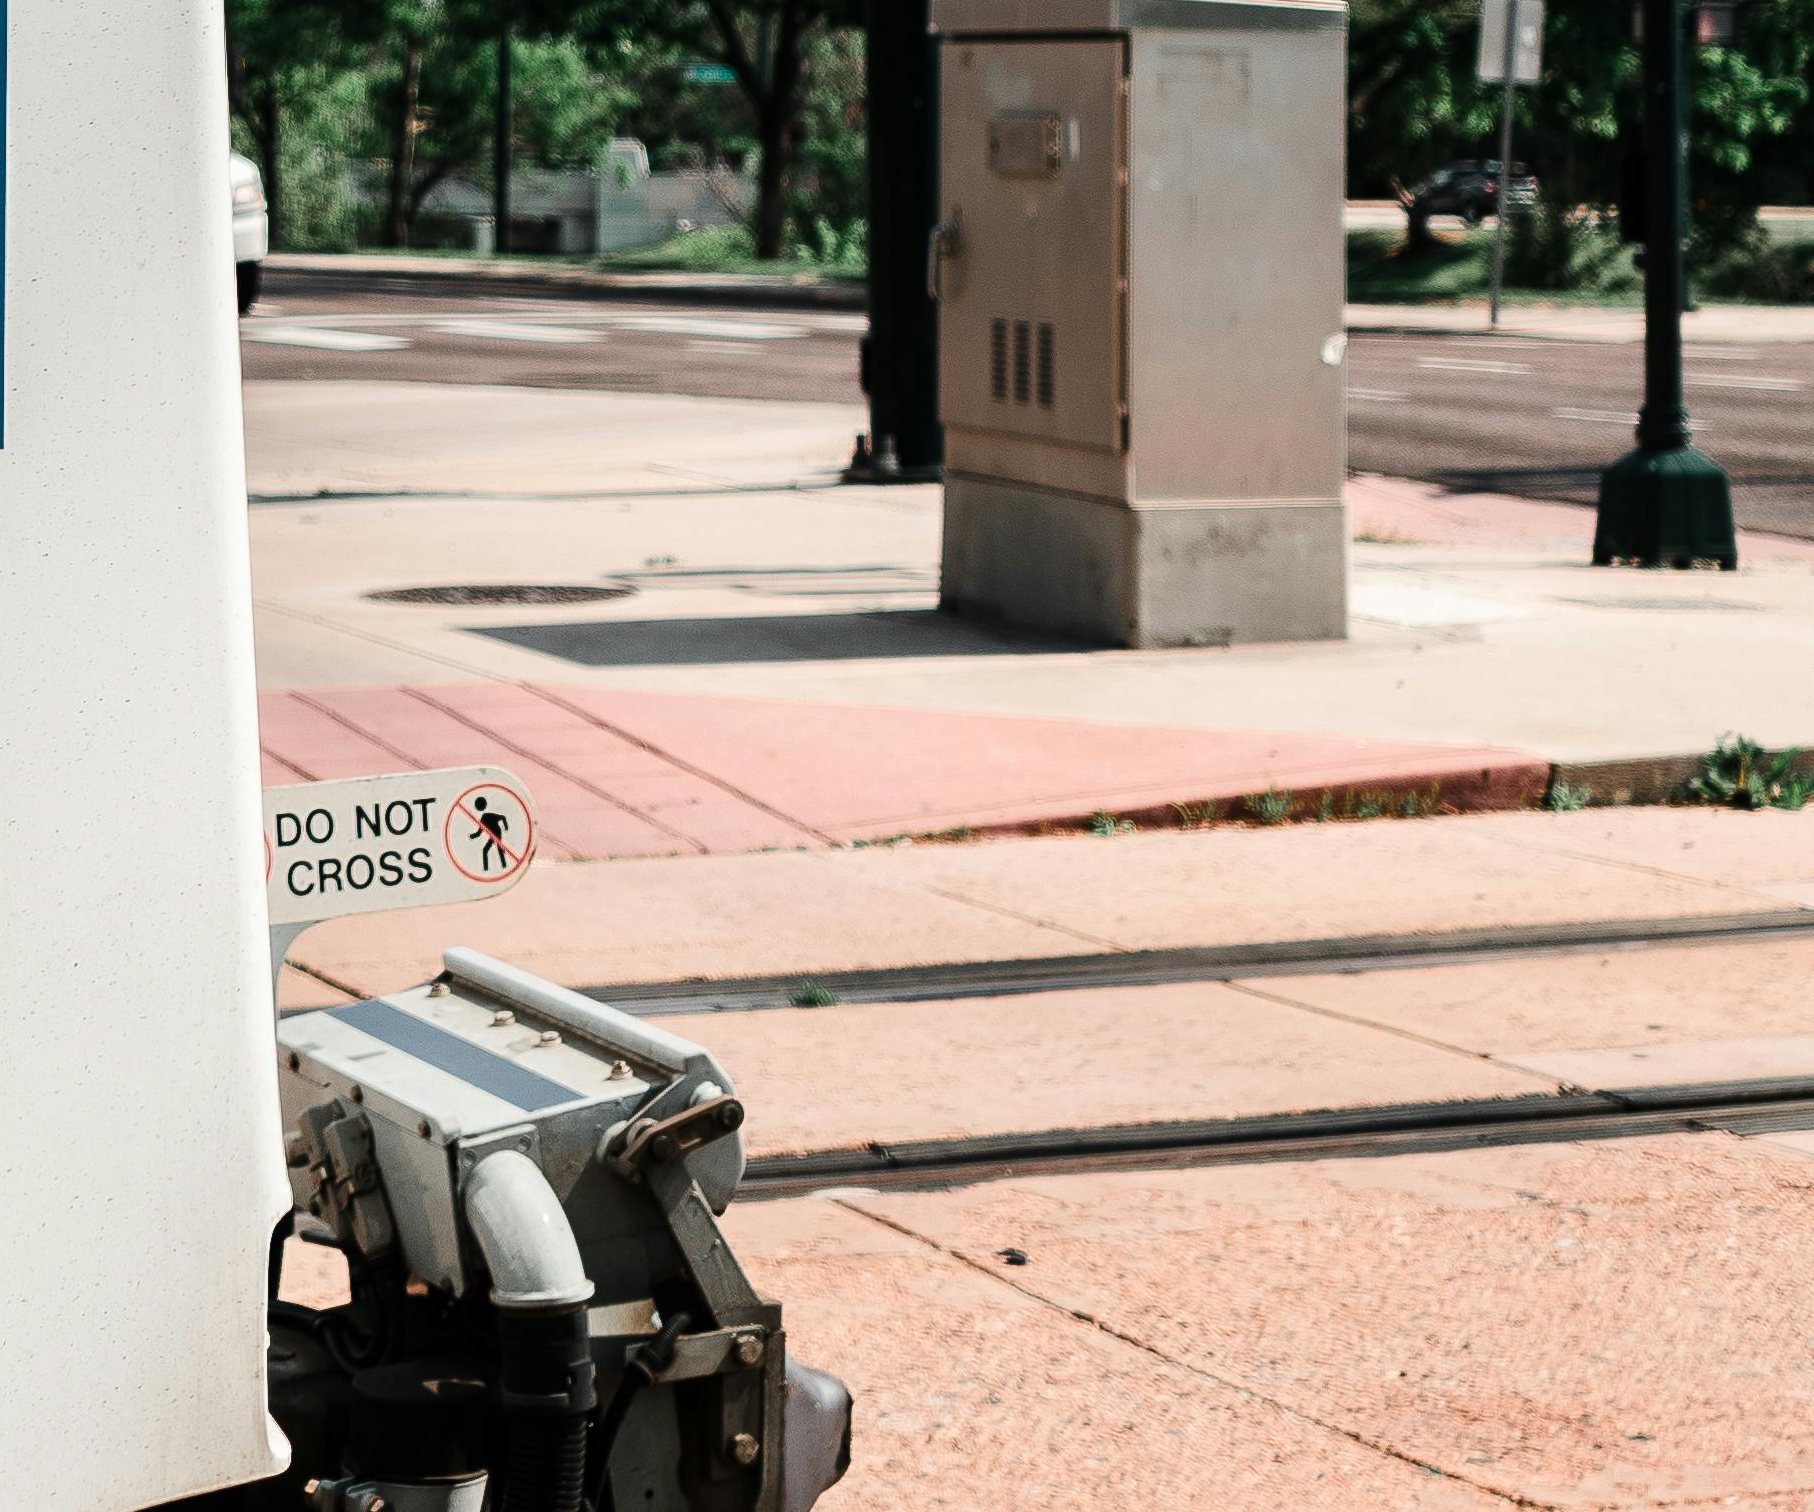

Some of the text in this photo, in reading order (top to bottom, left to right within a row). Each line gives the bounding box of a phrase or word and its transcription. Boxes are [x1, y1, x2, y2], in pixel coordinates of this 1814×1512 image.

[276, 797, 437, 847] DO NOT
[287, 847, 434, 896] CROSS
